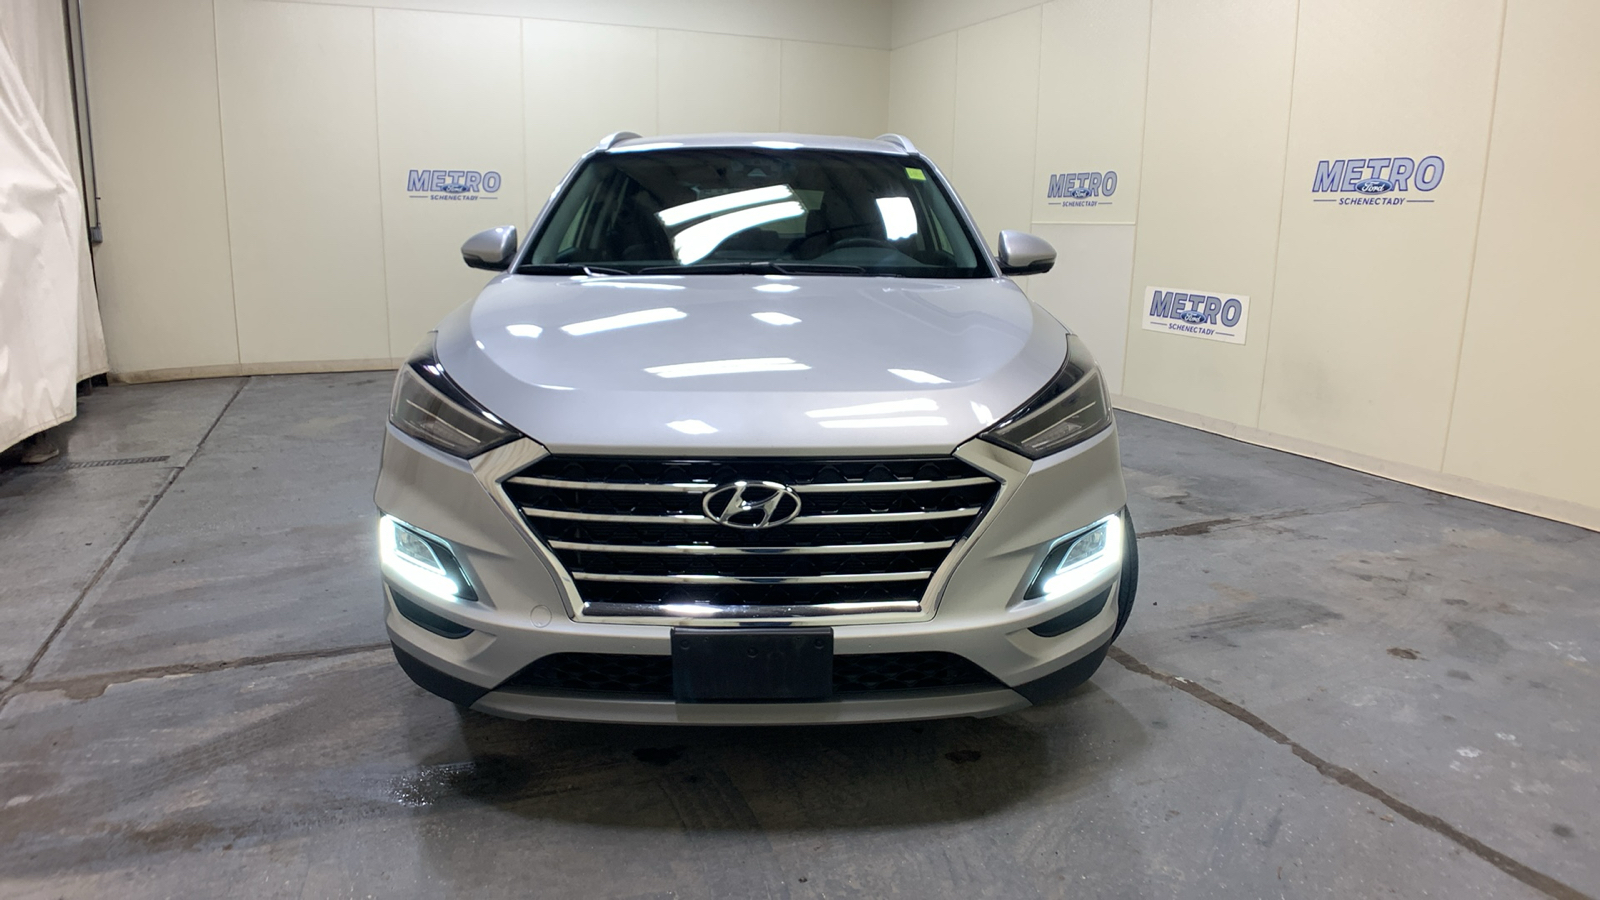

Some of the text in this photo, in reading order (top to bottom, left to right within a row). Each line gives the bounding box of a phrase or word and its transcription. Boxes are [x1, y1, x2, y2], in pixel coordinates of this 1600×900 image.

[407, 170, 501, 193] METRO
[1047, 171, 1117, 198] METRO
[1312, 156, 1445, 192] METRO
[1339, 197, 1405, 205] SCHENECTADY
[1149, 290, 1242, 328] METRO
[1168, 322, 1215, 335] SCHENECTADY
